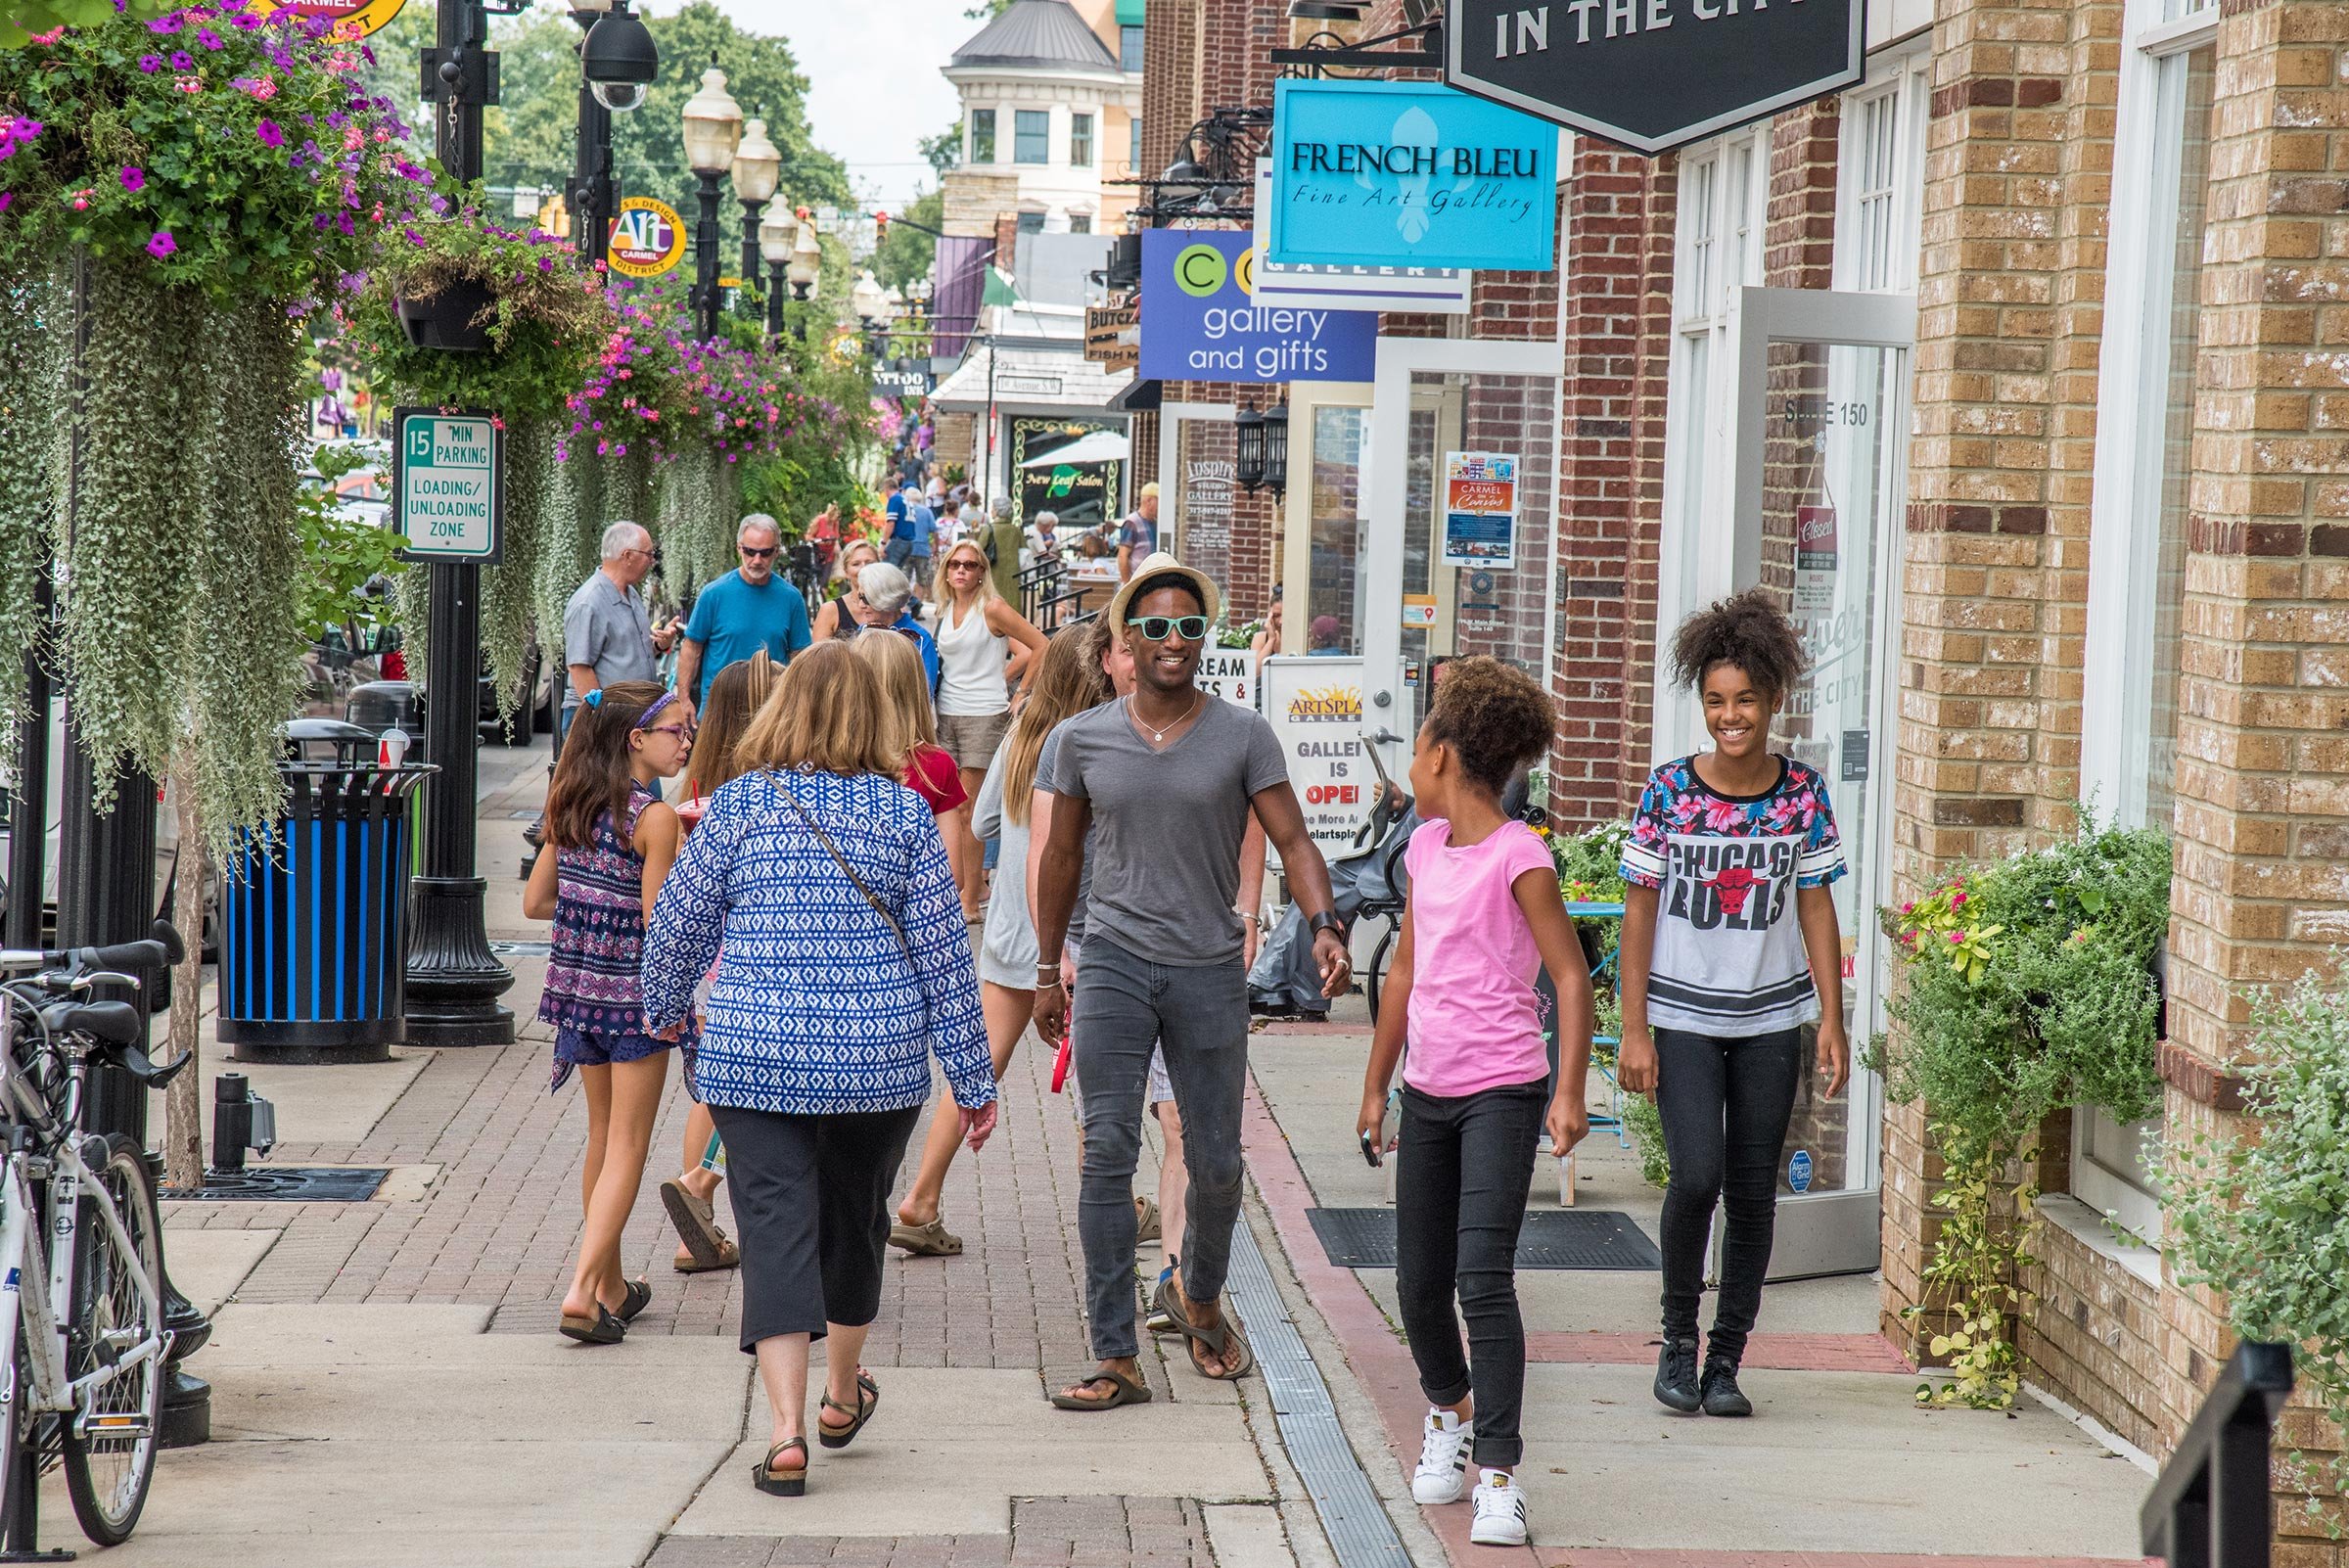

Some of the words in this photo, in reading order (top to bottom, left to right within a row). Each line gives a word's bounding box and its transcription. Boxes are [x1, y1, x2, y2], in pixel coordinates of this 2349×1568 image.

[1496, 7, 1548, 59] IN
[1567, 0, 1674, 44] THE
[1292, 143, 1438, 175] FRENCH
[1452, 147, 1538, 177] BLEU
[1293, 184, 1348, 203] Fine
[1362, 187, 1412, 207] Art
[1430, 183, 1534, 222] Gallery
[642, 201, 677, 224] DESIGN
[621, 251, 659, 260] CARMEL
[616, 259, 666, 274] DISTRICT
[1204, 305, 1328, 341] gallery
[1088, 349, 1123, 360] FISH
[1188, 346, 1244, 370] and
[1255, 340, 1328, 378] gifts
[1841, 402, 1867, 427] 150
[410, 431, 430, 456] 15
[451, 425, 473, 442] MIN
[437, 446, 486, 464] PARKING
[414, 479, 482, 496] LOADING/
[1026, 473, 1051, 485] New
[1052, 474, 1077, 488] Leaf
[1076, 475, 1103, 486] Salon
[1460, 484, 1501, 494] CARMEL
[1187, 490, 1233, 501] GALLERY
[1456, 493, 1503, 509] Canvas
[410, 500, 486, 518] UNLOADING
[430, 522, 465, 537] ZONE
[1800, 512, 1833, 543] Closed
[1194, 658, 1245, 676] REAM
[1236, 683, 1245, 699] &
[1825, 673, 1862, 705] CITY
[1330, 761, 1348, 777] IS
[1318, 814, 1345, 824] More
[1310, 828, 1357, 841] elartspla
